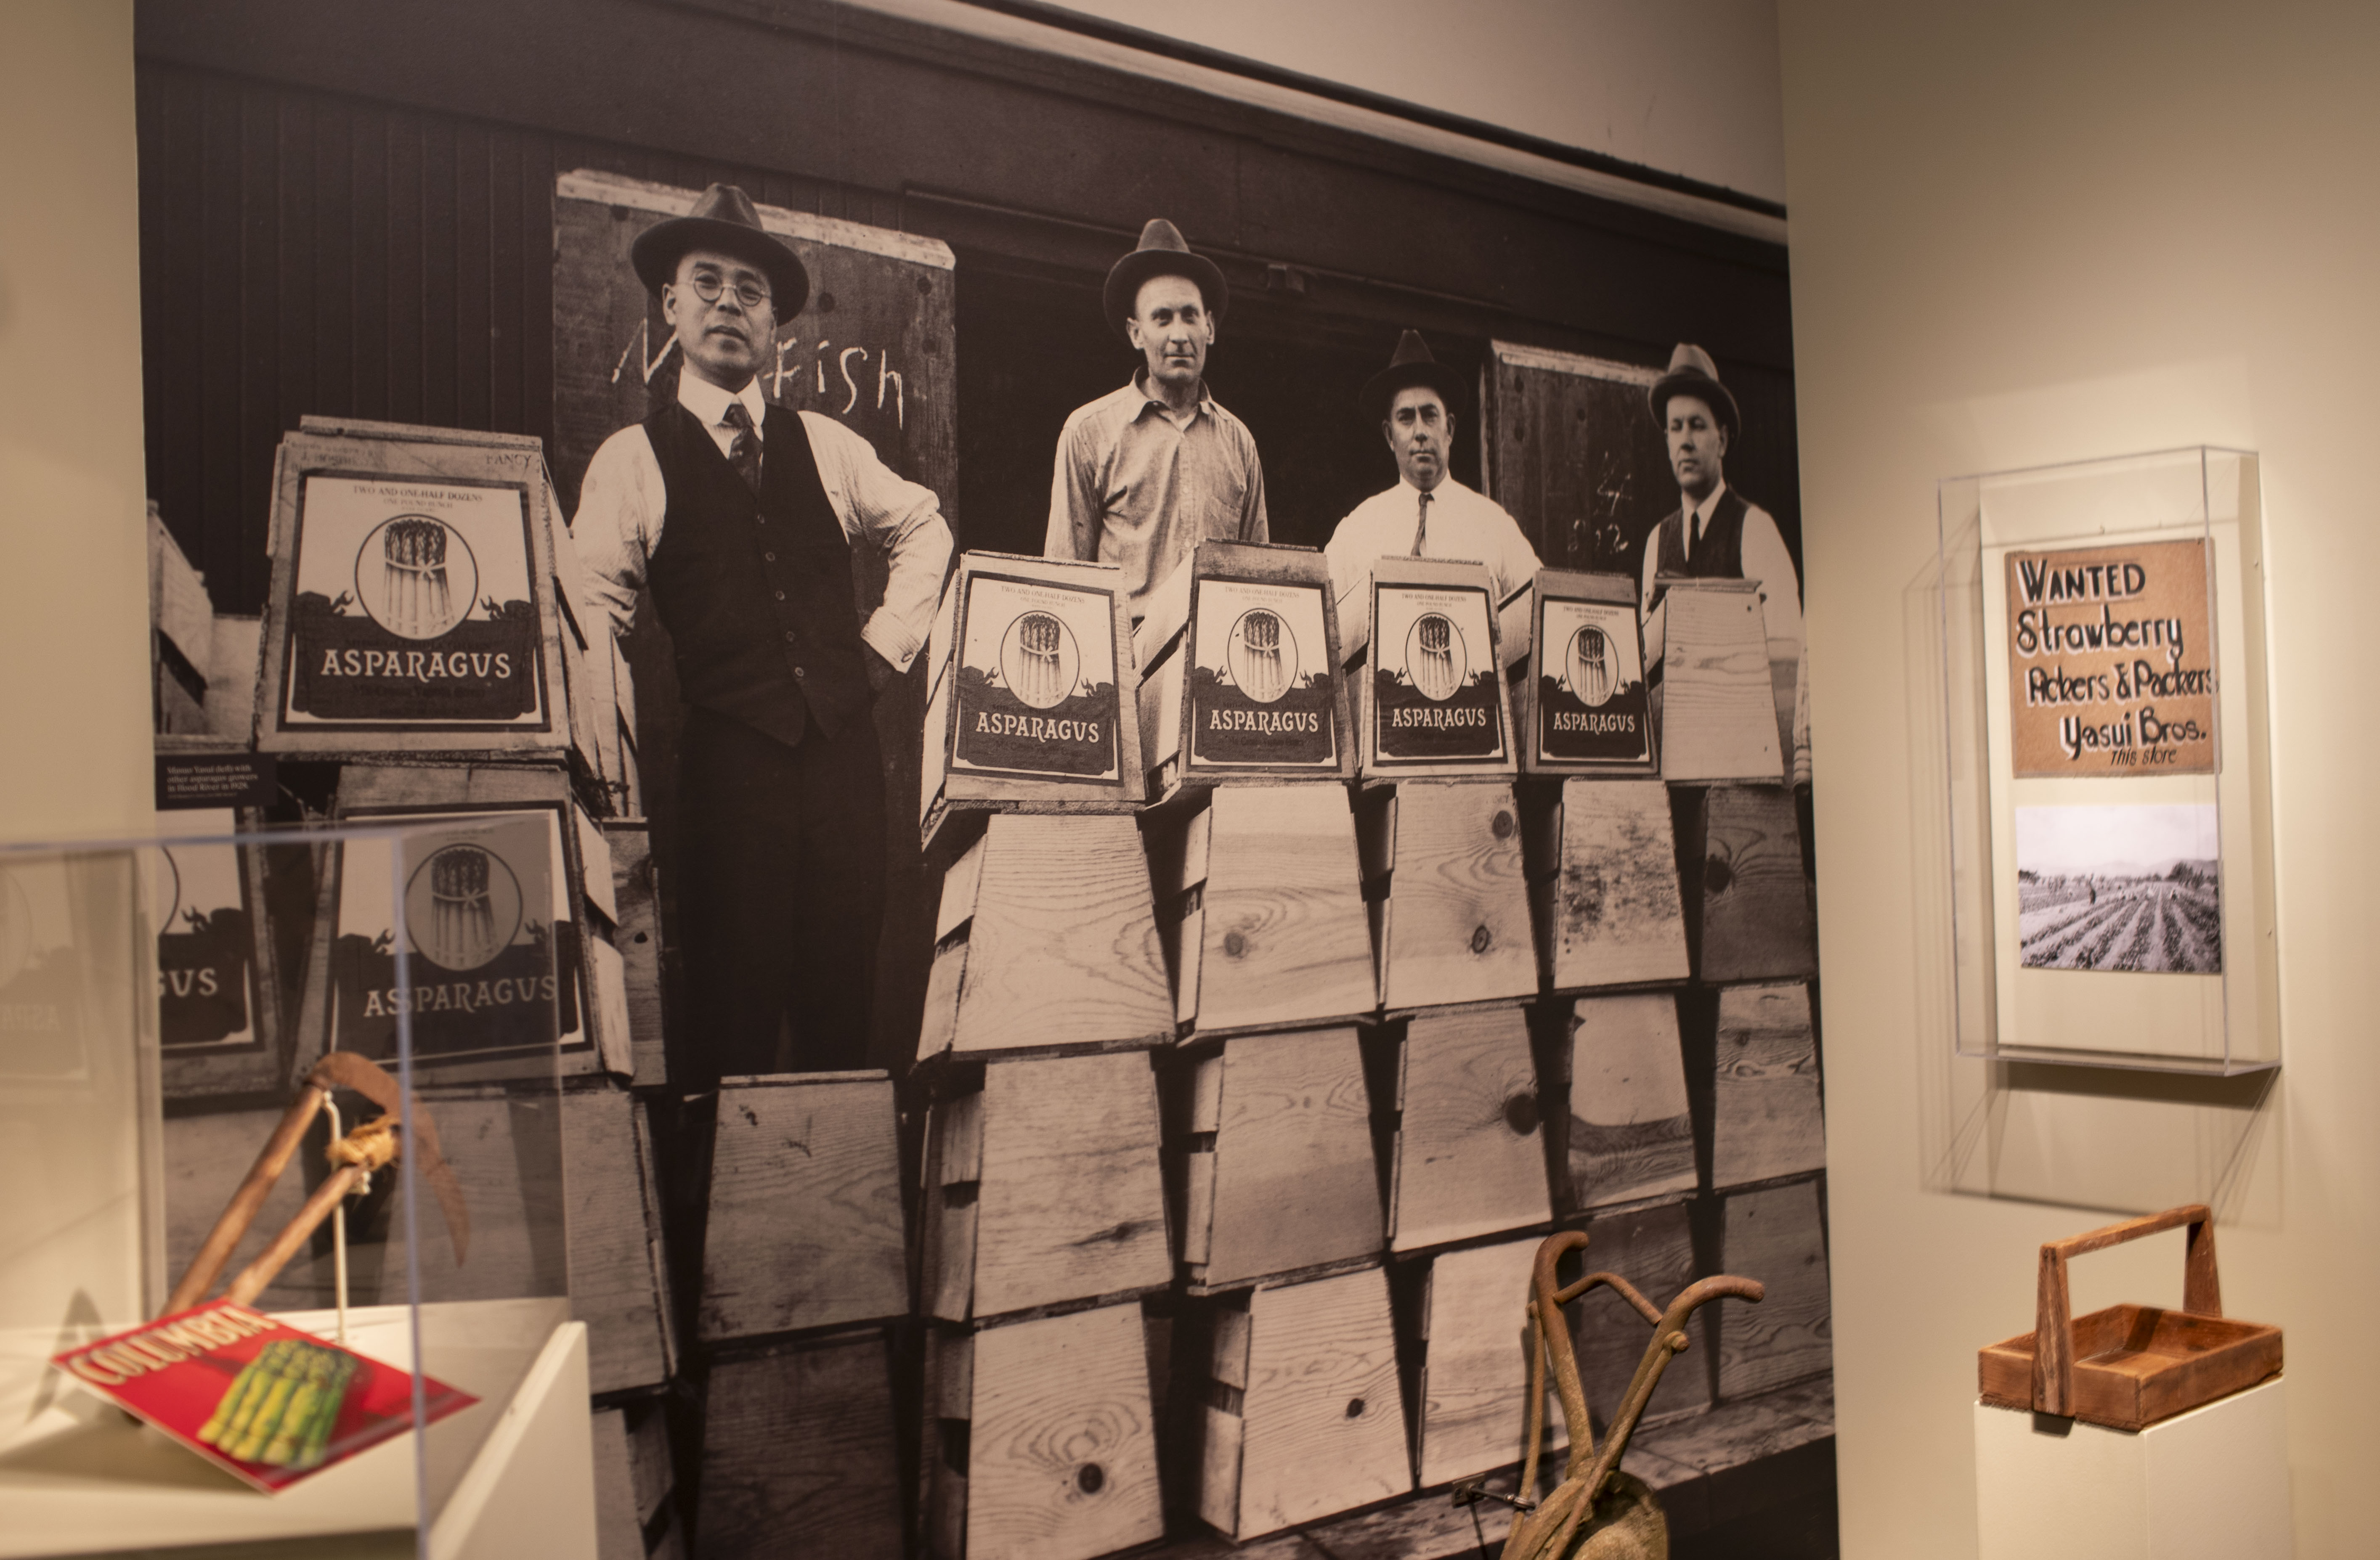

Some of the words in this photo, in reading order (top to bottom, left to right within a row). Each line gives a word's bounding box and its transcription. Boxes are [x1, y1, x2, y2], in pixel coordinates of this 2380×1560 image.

[353, 486, 375, 494] TWO
[379, 487, 398, 496] AND
[447, 491, 483, 502] DOZENS
[2017, 559, 2146, 606] WANTED
[2016, 603, 2184, 662] Strawberry
[320, 649, 512, 684] ASPARAGUS
[2112, 663, 2131, 702] &
[2132, 659, 2219, 699] Packers
[975, 711, 1100, 744] ASPARAGUS
[1209, 709, 1319, 736] ASPARAGUS
[1391, 707, 1486, 731] ASPARAGUS
[1553, 712, 1635, 735] ASPARAGUS
[2061, 712, 2132, 761] Yasui
[2137, 706, 2207, 746] Bros.
[363, 975, 557, 1017] ASPARAGUS
